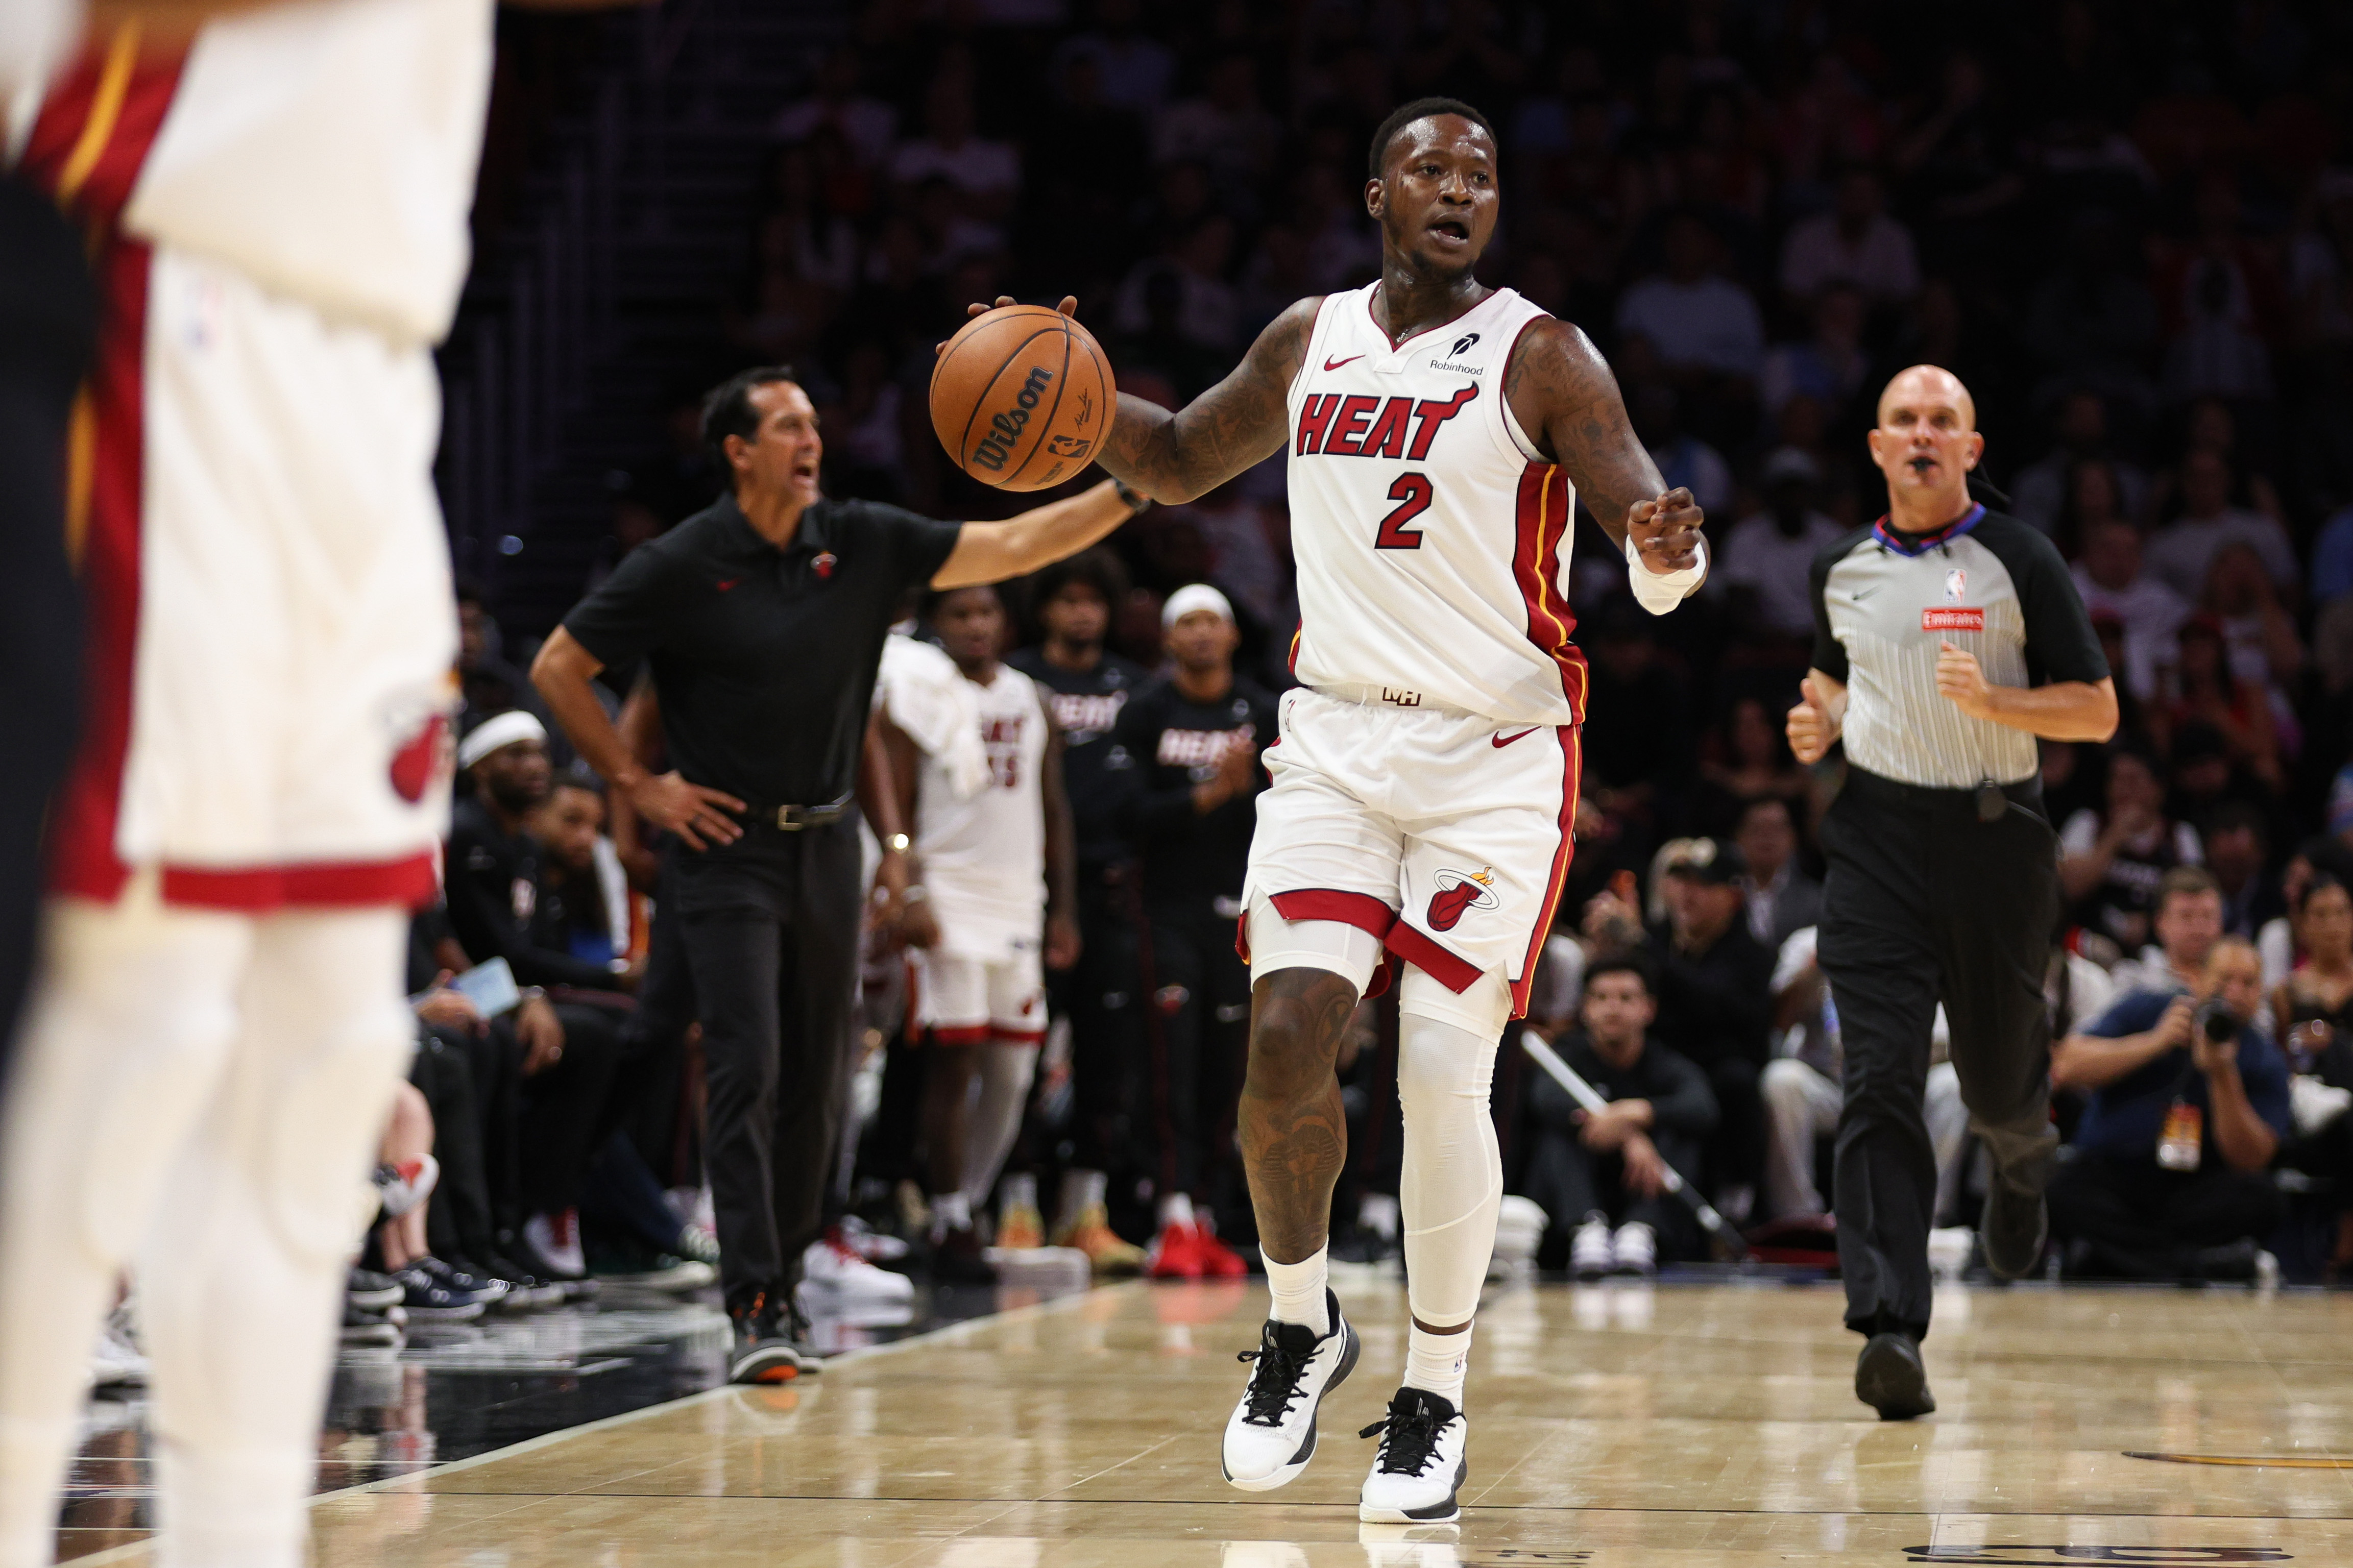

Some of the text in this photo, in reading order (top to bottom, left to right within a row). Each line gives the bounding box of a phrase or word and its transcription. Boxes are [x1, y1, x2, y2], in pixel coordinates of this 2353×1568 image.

[1430, 360, 1484, 376] Robinhood
[972, 366, 1054, 472] Wilson
[1296, 380, 1479, 461] HEAT
[1374, 471, 1434, 550] 2
